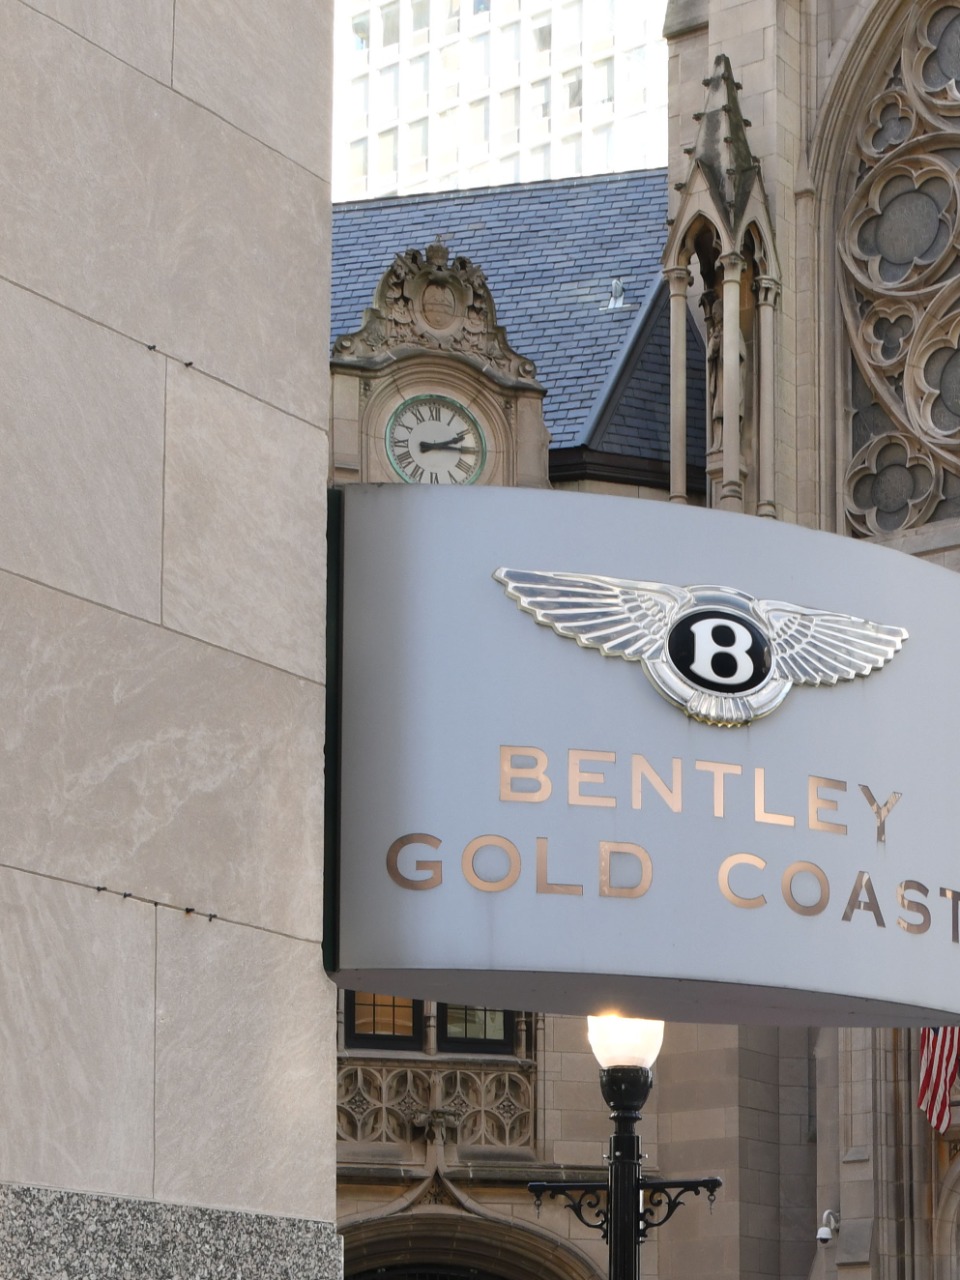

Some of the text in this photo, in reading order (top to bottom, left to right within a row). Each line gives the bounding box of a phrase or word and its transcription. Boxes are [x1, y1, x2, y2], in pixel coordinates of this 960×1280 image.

[689, 617, 755, 685] B
[499, 745, 903, 843] BENTLEY
[385, 832, 654, 899] GOLD
